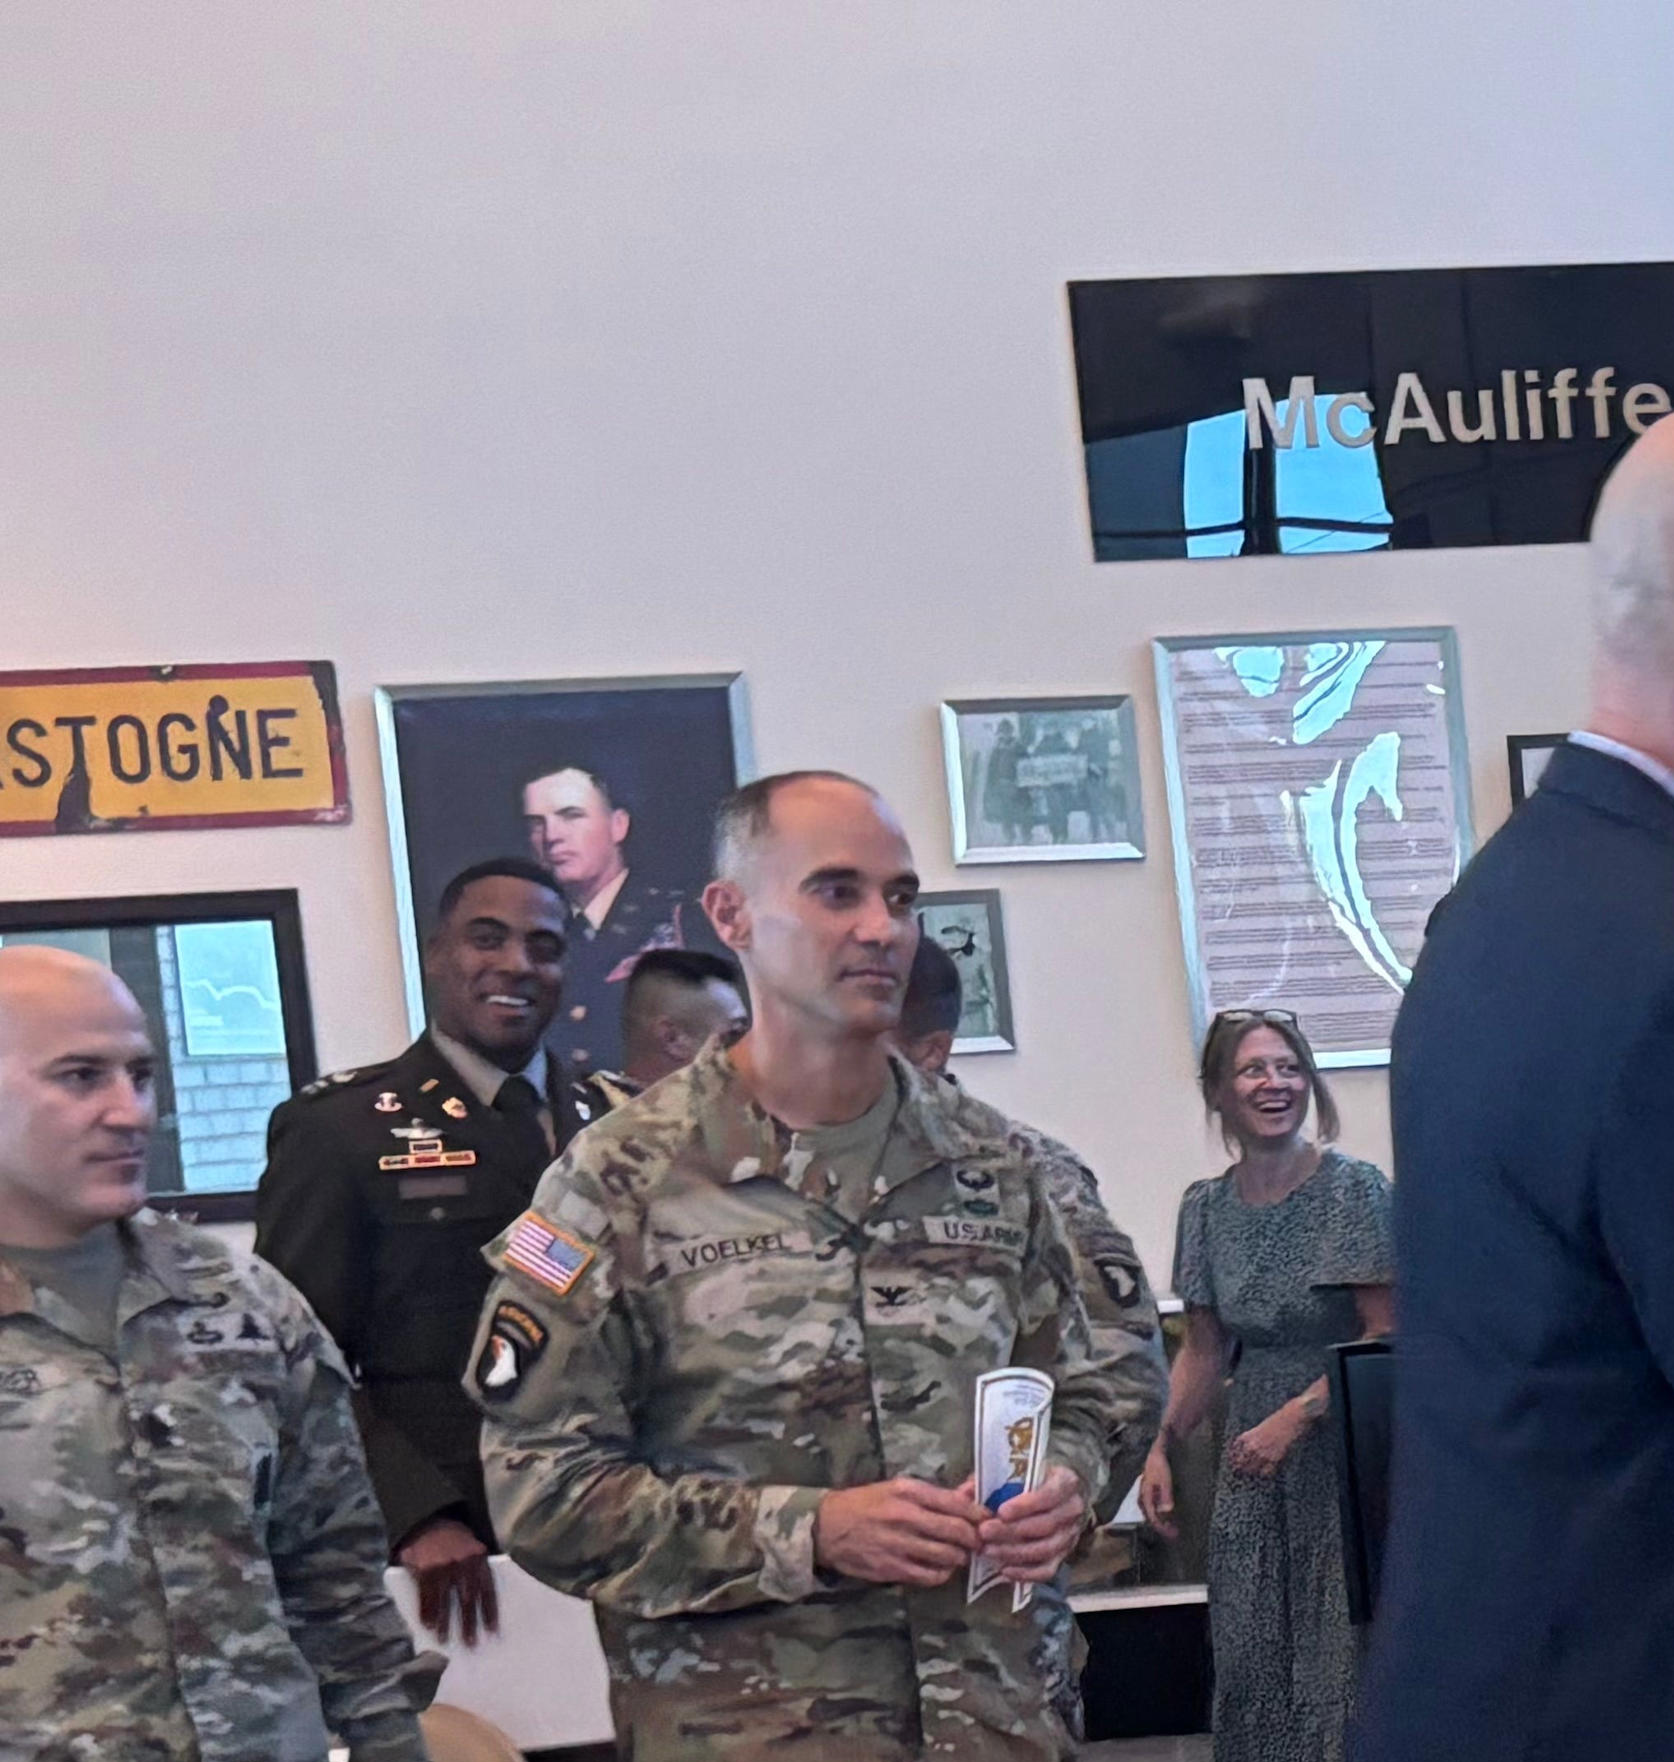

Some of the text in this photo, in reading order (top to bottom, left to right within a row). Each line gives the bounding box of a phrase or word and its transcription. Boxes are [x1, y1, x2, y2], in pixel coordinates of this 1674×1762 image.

[1243, 366, 1670, 450] McAuliffe
[0, 702, 304, 789] STOGNE
[681, 1232, 792, 1267] VOELKEL
